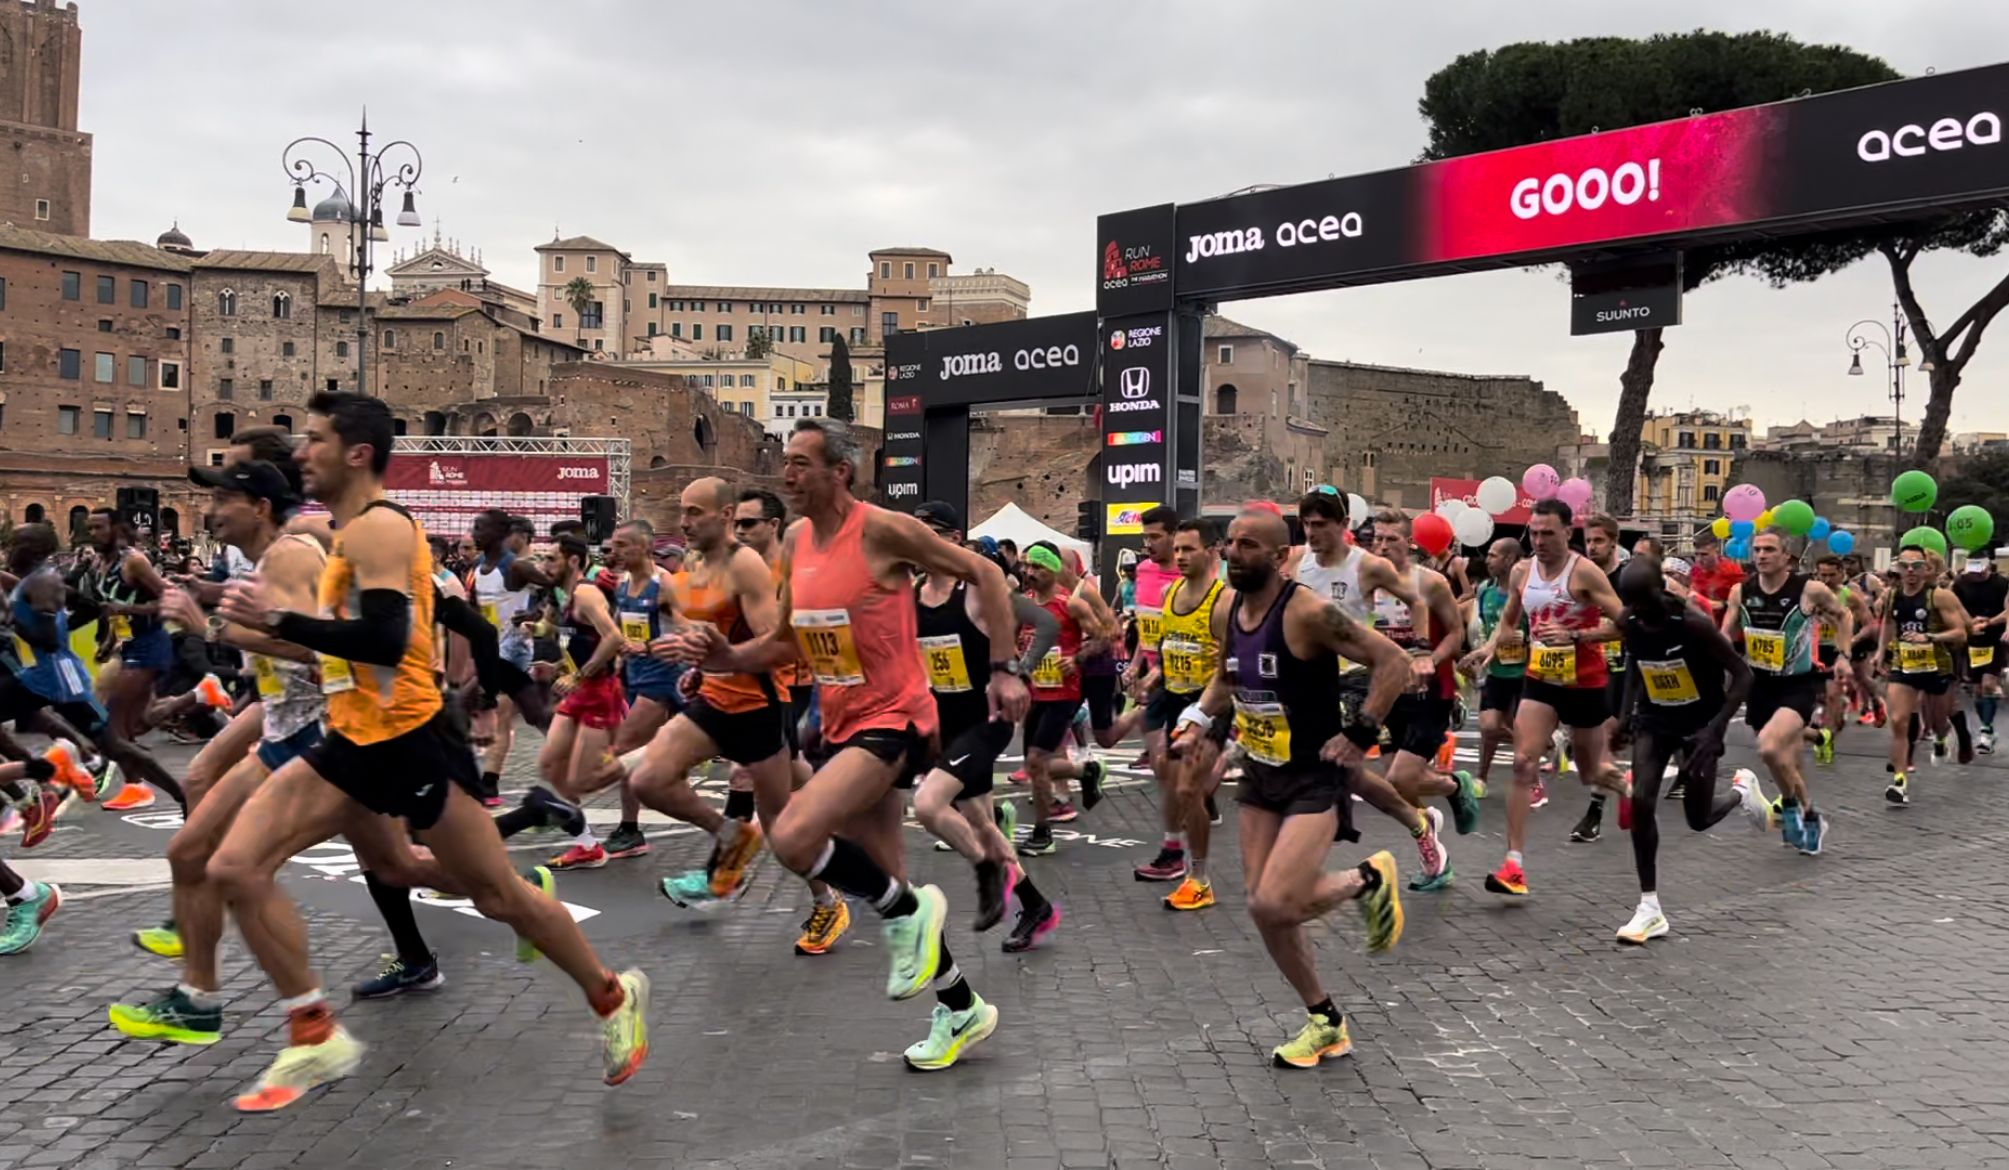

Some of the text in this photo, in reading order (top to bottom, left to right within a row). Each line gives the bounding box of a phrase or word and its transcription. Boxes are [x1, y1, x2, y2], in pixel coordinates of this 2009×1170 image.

[1857, 111, 2001, 162] acea
[1510, 158, 1661, 220] GOOO!
[1276, 212, 1363, 247] acea
[1125, 245, 1150, 260] RUN
[1130, 256, 1162, 271] ROME
[1103, 278, 1128, 290] acea
[1596, 306, 1651, 322] SUUNTO
[1128, 326, 1162, 338] REGIONE
[1128, 337, 1152, 348] LAZIO
[1014, 344, 1079, 370] acea
[1109, 400, 1160, 412] HONDA
[894, 432, 920, 440] HONDA
[1107, 462, 1161, 489] upim
[888, 482, 918, 499] upim
